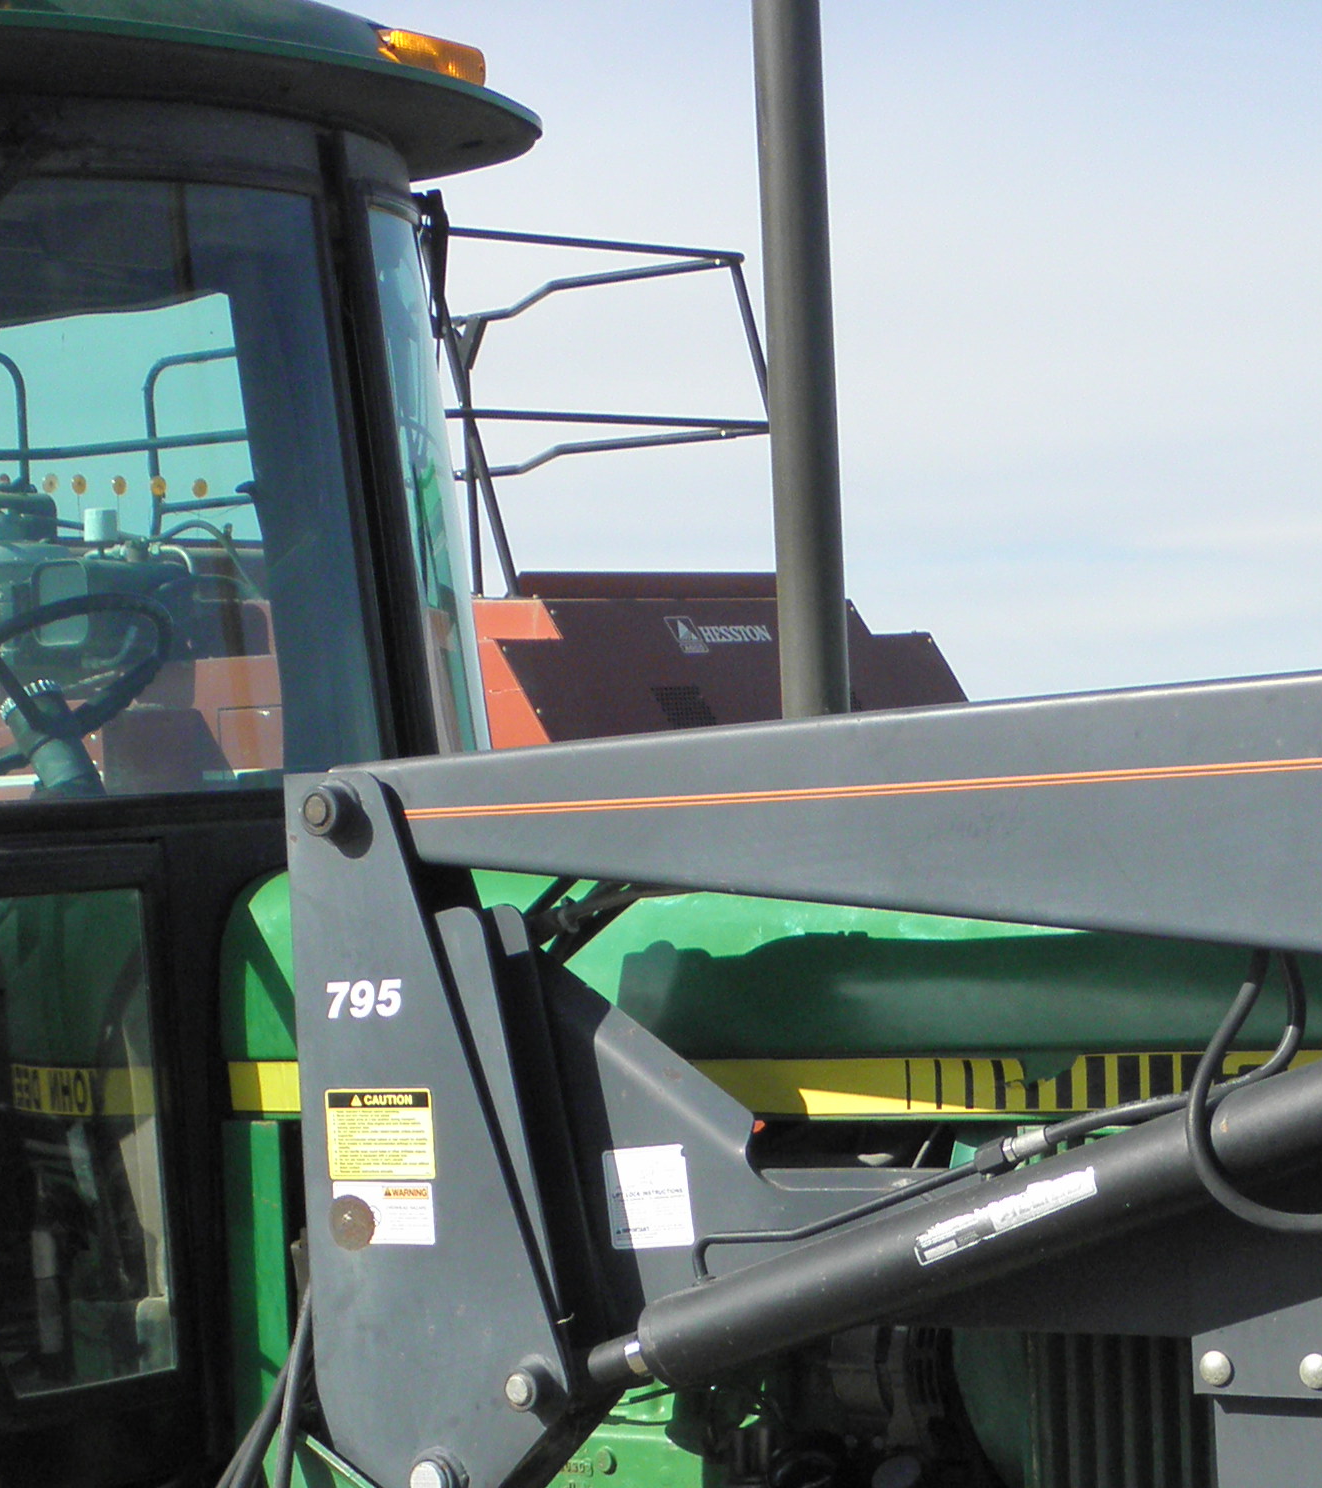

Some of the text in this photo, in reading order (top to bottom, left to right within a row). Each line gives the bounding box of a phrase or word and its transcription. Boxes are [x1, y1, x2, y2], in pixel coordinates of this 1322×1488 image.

[697, 624, 773, 643] HESSTON
[325, 978, 402, 1020] 795
[363, 1094, 413, 1106] CAUTION
[393, 1188, 427, 1197] WARNING
